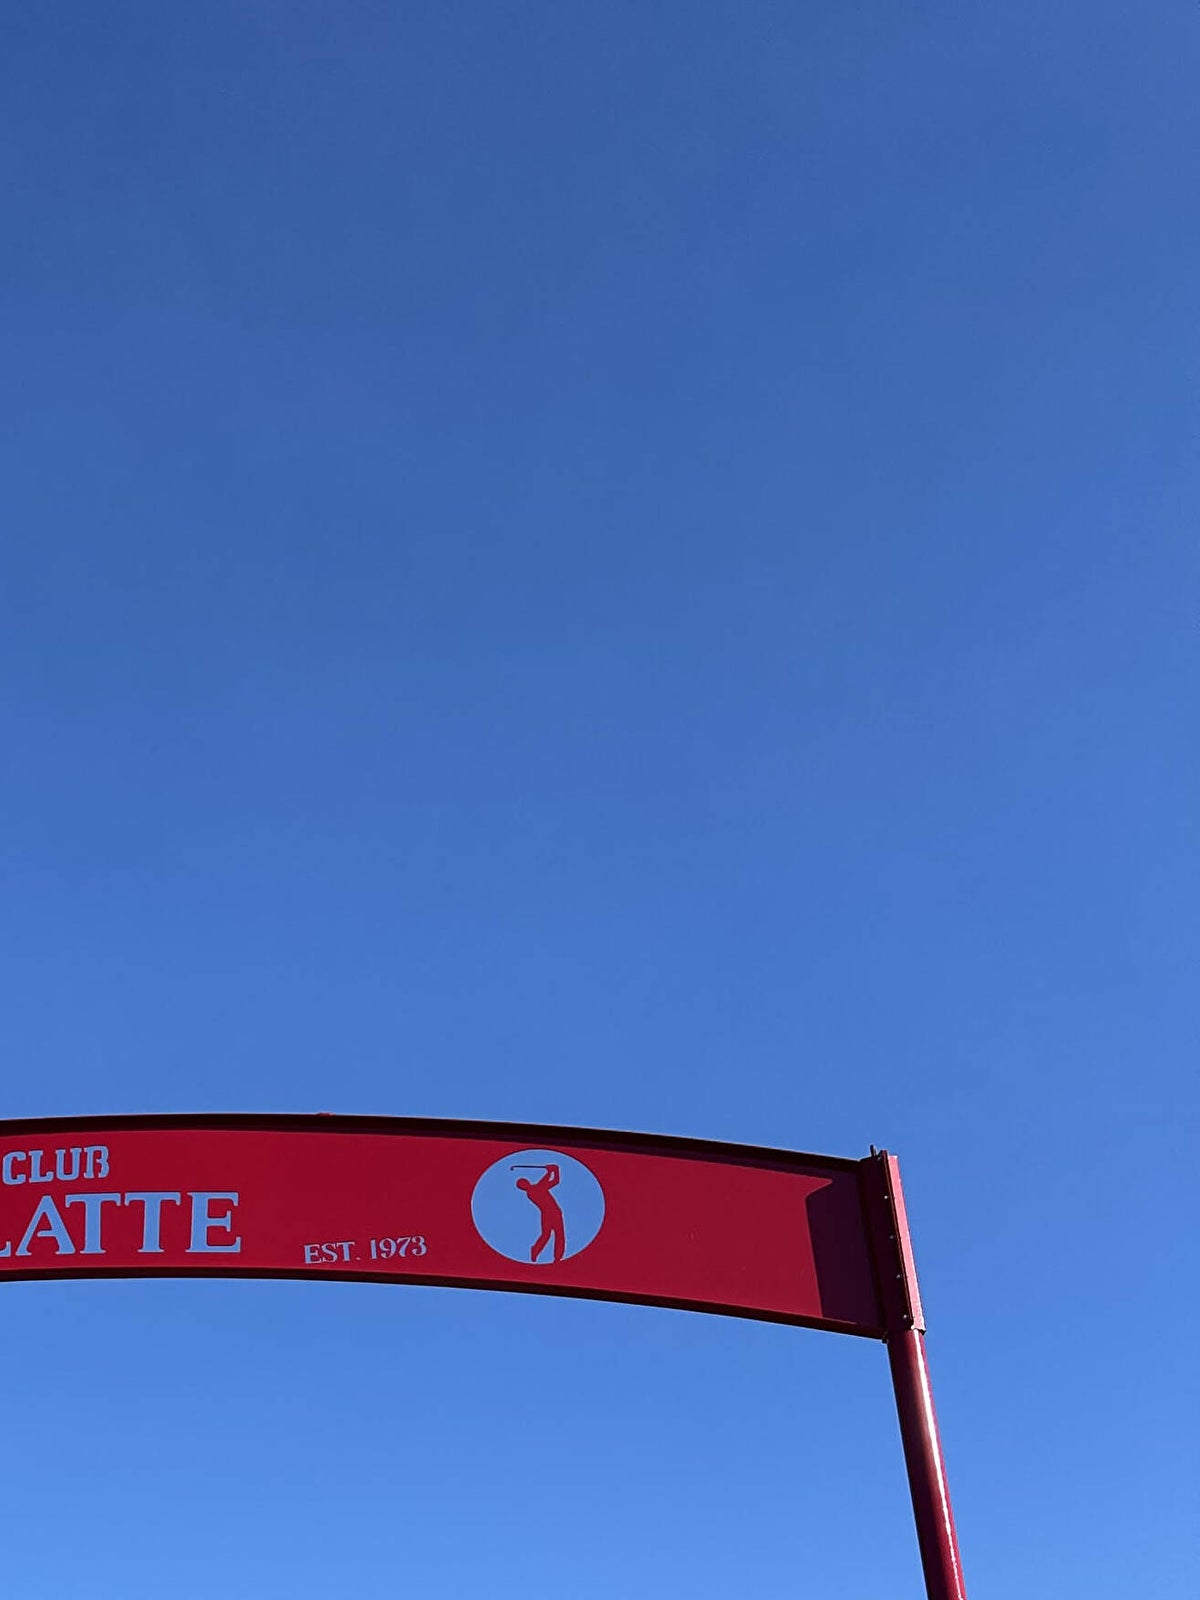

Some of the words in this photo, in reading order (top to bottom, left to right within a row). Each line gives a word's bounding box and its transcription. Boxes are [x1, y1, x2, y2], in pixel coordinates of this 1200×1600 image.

[2, 1145, 110, 1186] CLUB
[303, 1241, 361, 1265] EST.
[369, 1235, 427, 1260] 1973
